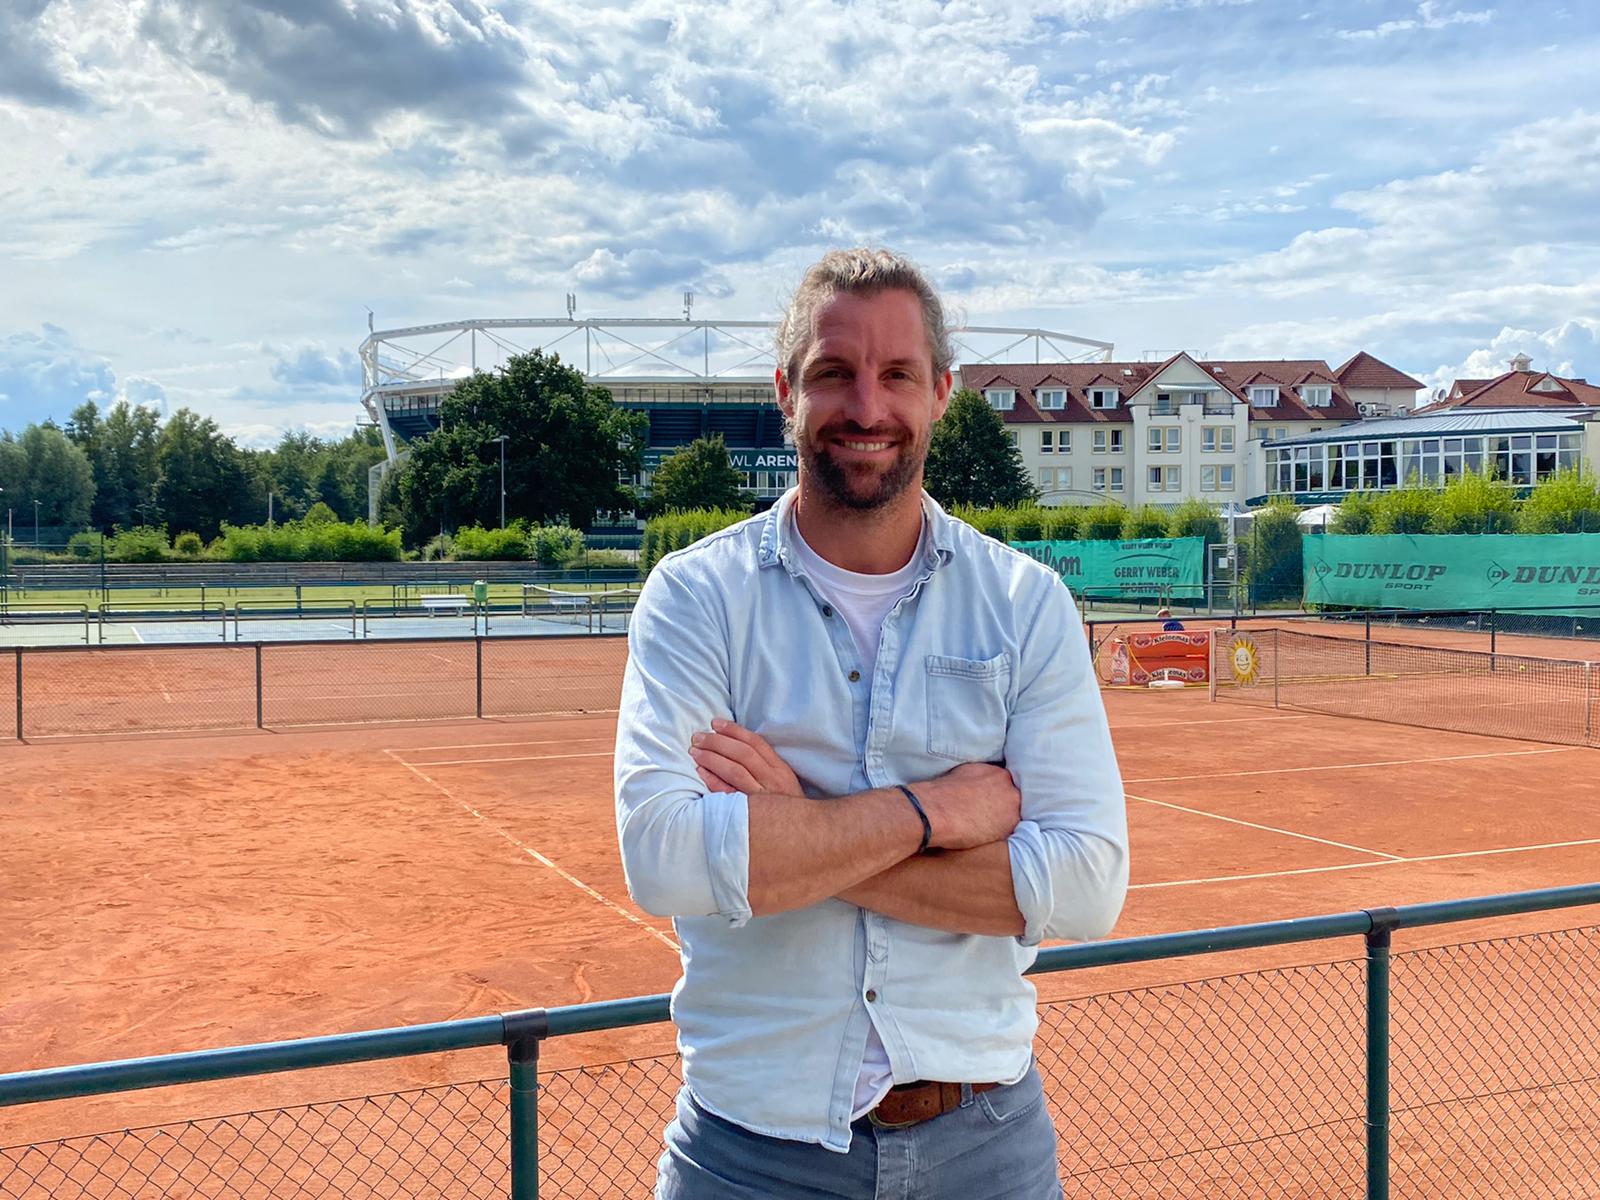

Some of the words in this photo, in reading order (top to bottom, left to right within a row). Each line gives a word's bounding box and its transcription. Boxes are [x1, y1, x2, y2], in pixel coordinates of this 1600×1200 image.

[729, 455, 752, 467] WL
[755, 455, 798, 467] AREN
[1114, 566, 1144, 578] GERRY
[1146, 566, 1180, 578] WEBER
[1334, 562, 1447, 581] DUNLOP
[1384, 582, 1433, 591] SPORT
[1151, 669, 1187, 679] Kleiemas
